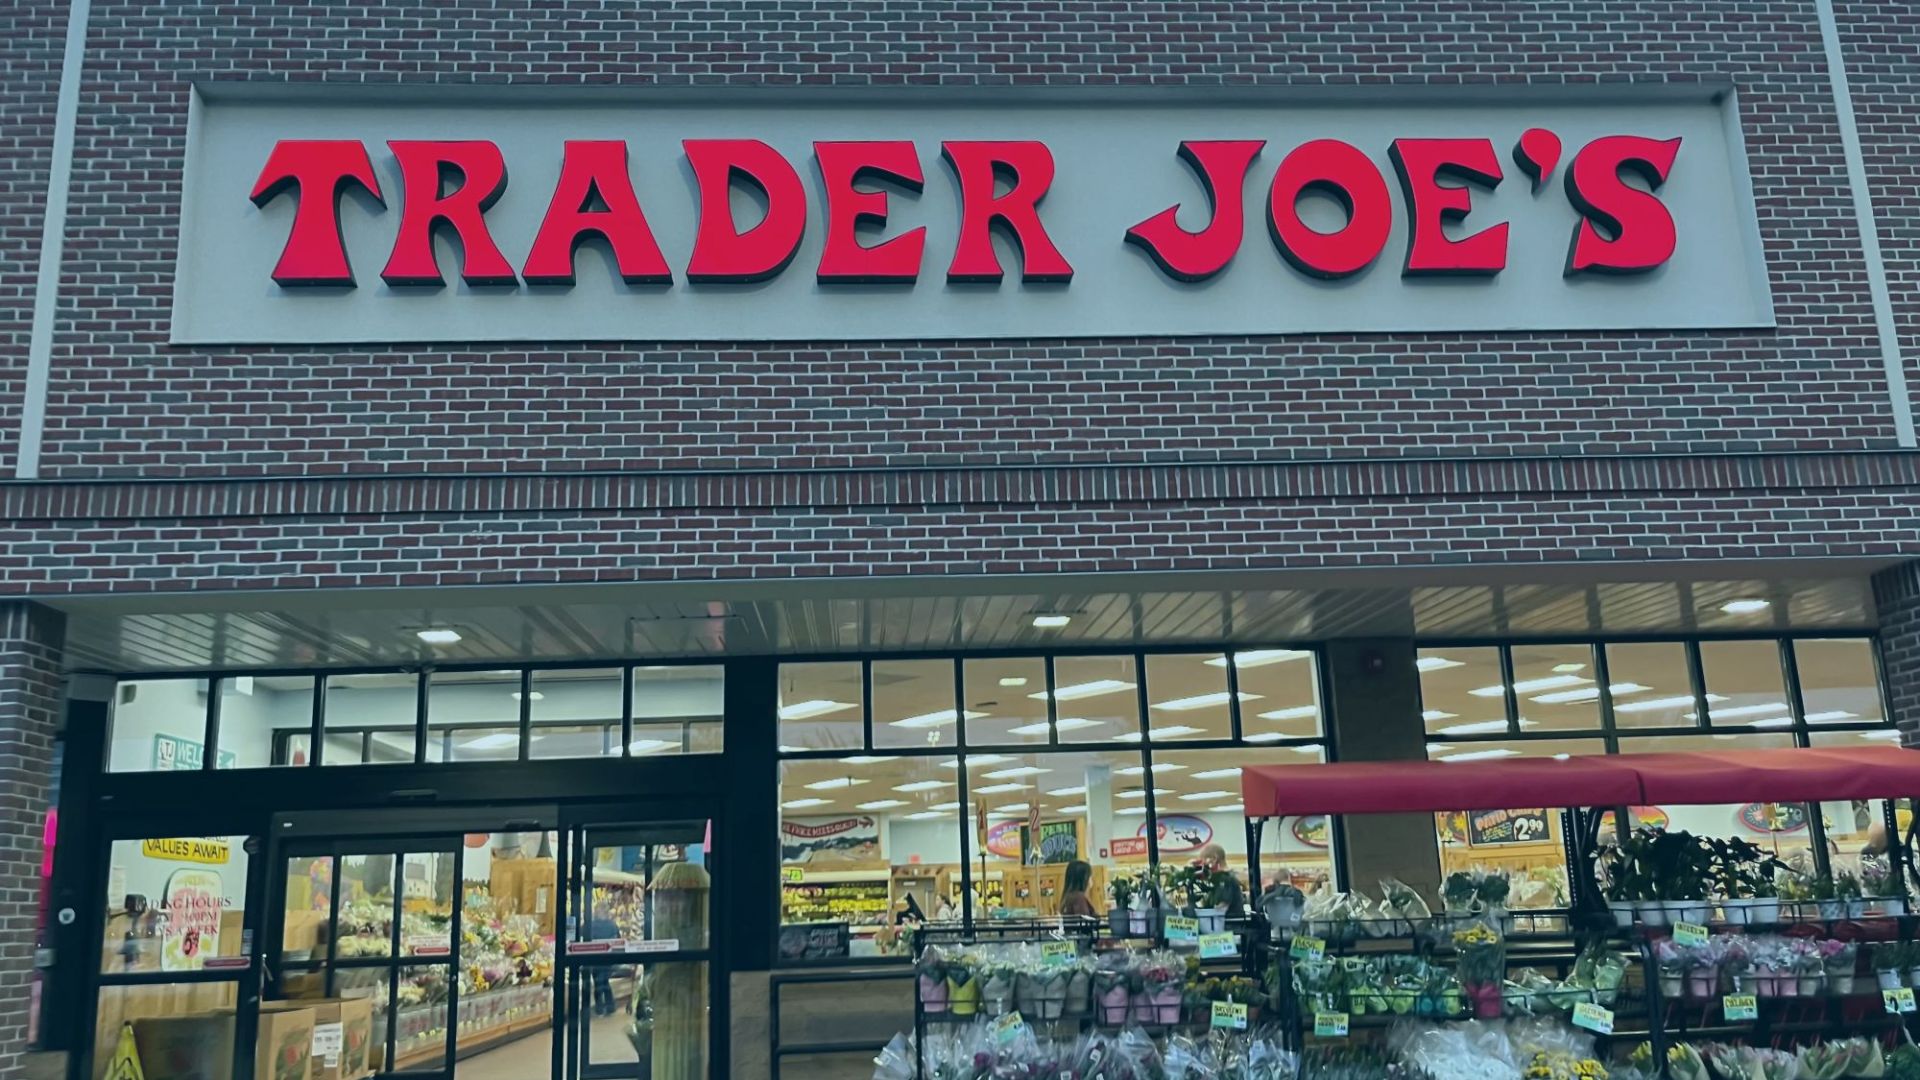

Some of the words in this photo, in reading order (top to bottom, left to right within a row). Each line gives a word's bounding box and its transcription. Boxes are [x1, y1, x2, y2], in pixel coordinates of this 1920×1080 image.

[248, 139, 1074, 289] TRADER
[1123, 128, 1683, 283] JOE'S
[1029, 807, 1040, 832] 2
[1514, 817, 1544, 840] 2.99
[146, 838, 189, 856] VALUES
[192, 844, 228, 859] AWAIT
[186, 896, 232, 909] HOURS
